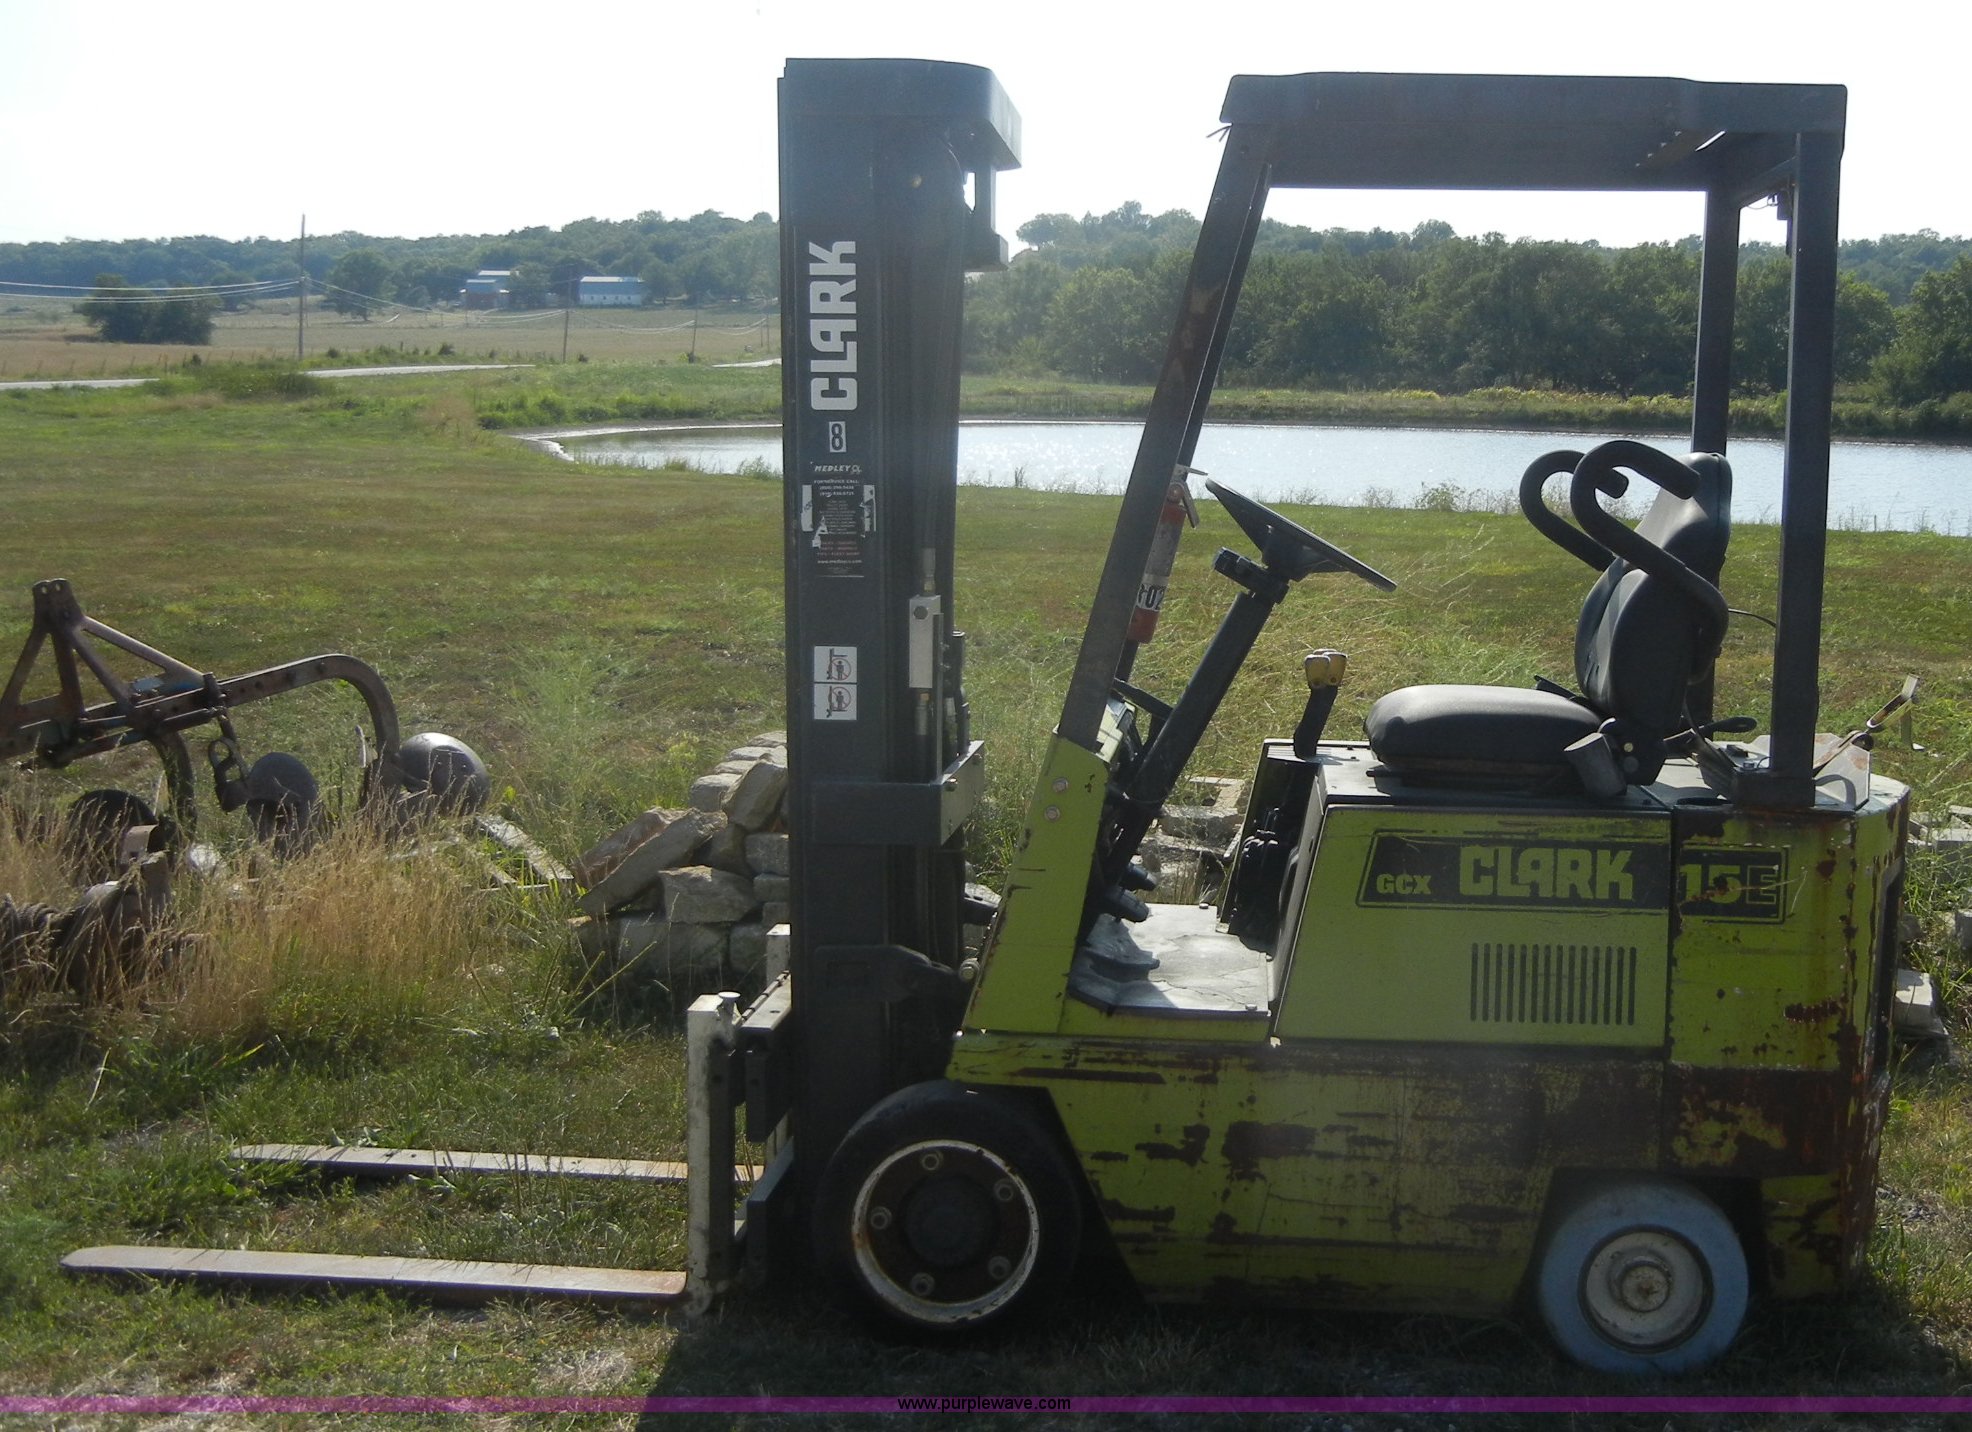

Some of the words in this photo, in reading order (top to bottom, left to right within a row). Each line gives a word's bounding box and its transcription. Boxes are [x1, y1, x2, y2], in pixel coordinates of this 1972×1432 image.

[809, 241, 858, 411] CLARK
[831, 423, 844, 451] 8
[814, 464, 851, 473] MEDLEY
[1376, 872, 1432, 895] GCX
[1459, 845, 1633, 900] CLARK
